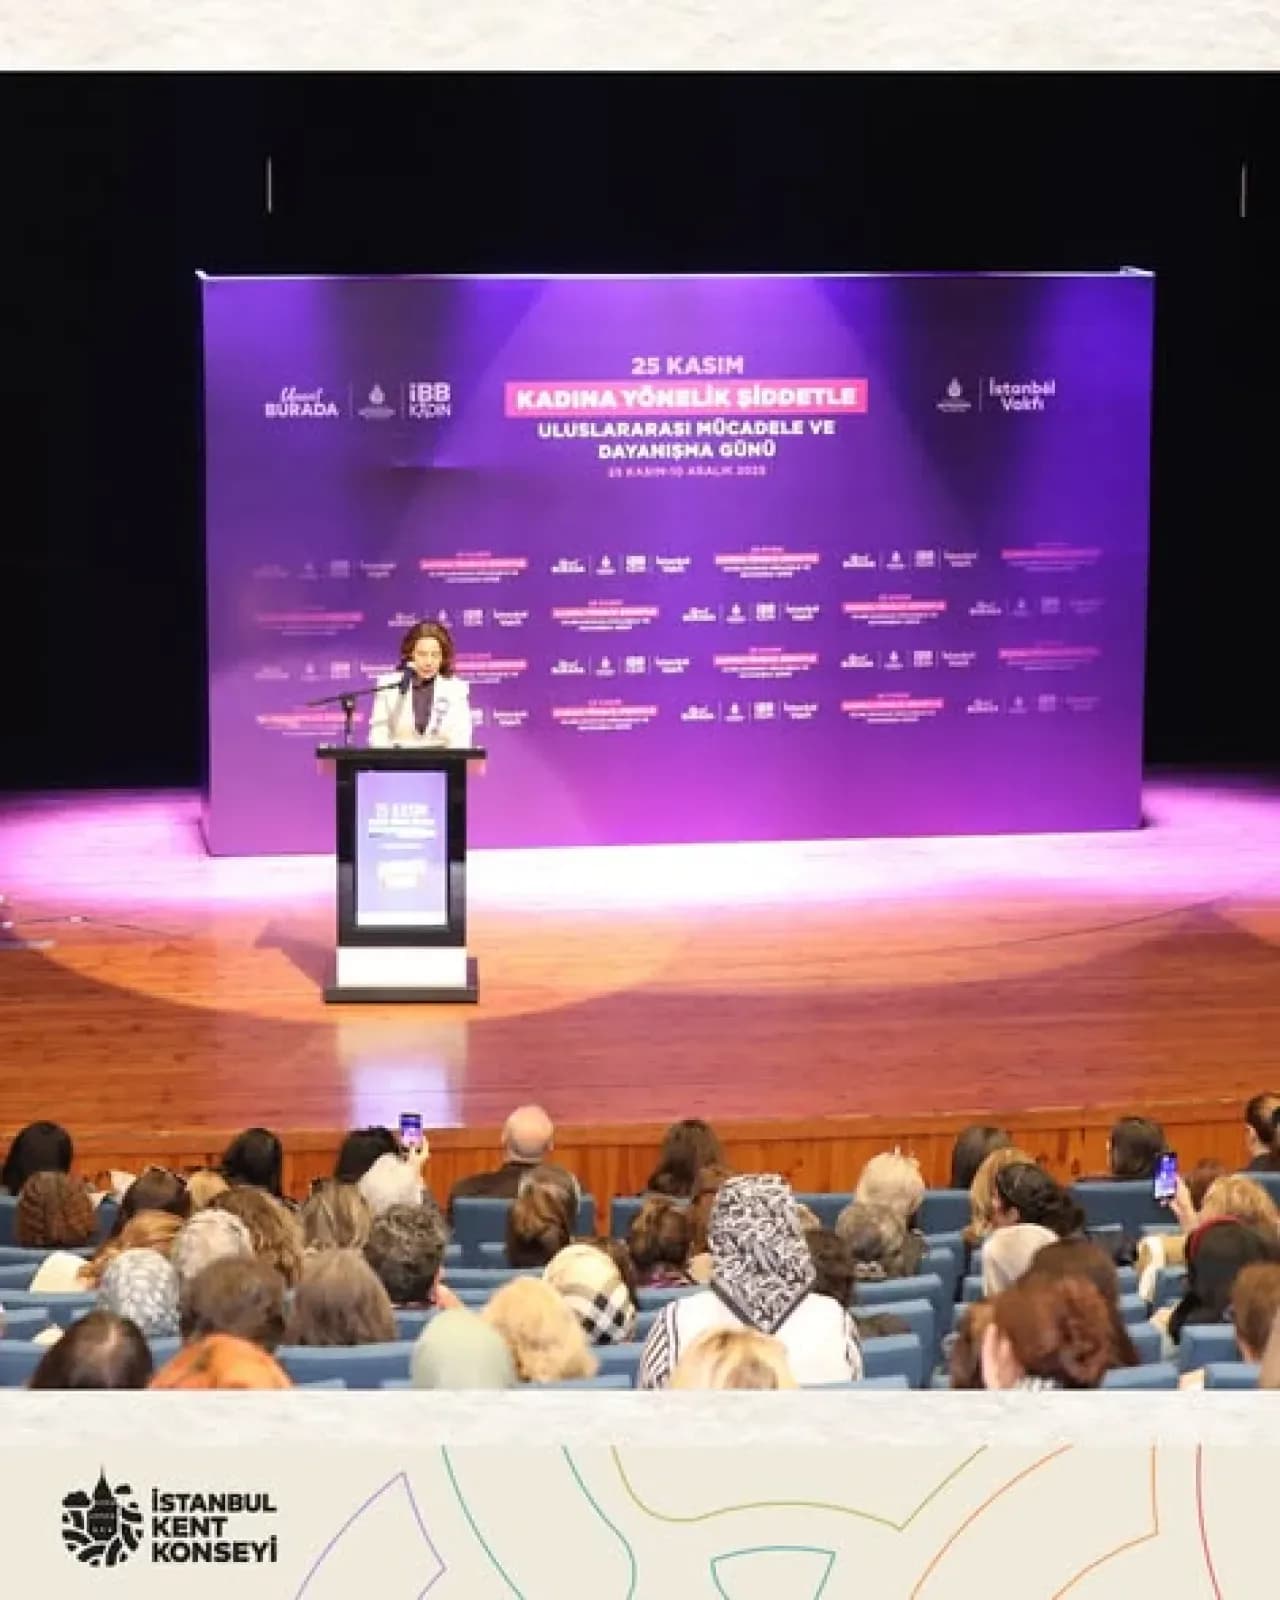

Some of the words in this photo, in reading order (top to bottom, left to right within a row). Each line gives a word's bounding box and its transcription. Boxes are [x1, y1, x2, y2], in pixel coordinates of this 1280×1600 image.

[631, 356, 660, 375] 25
[666, 355, 744, 375] KASIM
[516, 389, 617, 409] KADINA
[622, 384, 731, 408] YÖNELİK
[736, 384, 857, 409] ŞİDDETLE
[265, 402, 340, 417] BURADA
[538, 421, 692, 438] ULUSLARARASI
[696, 417, 804, 437] MÜCADELE
[808, 419, 837, 435] VE
[598, 442, 714, 461] DAYANIŞMA
[718, 439, 777, 457] GÜNÜ
